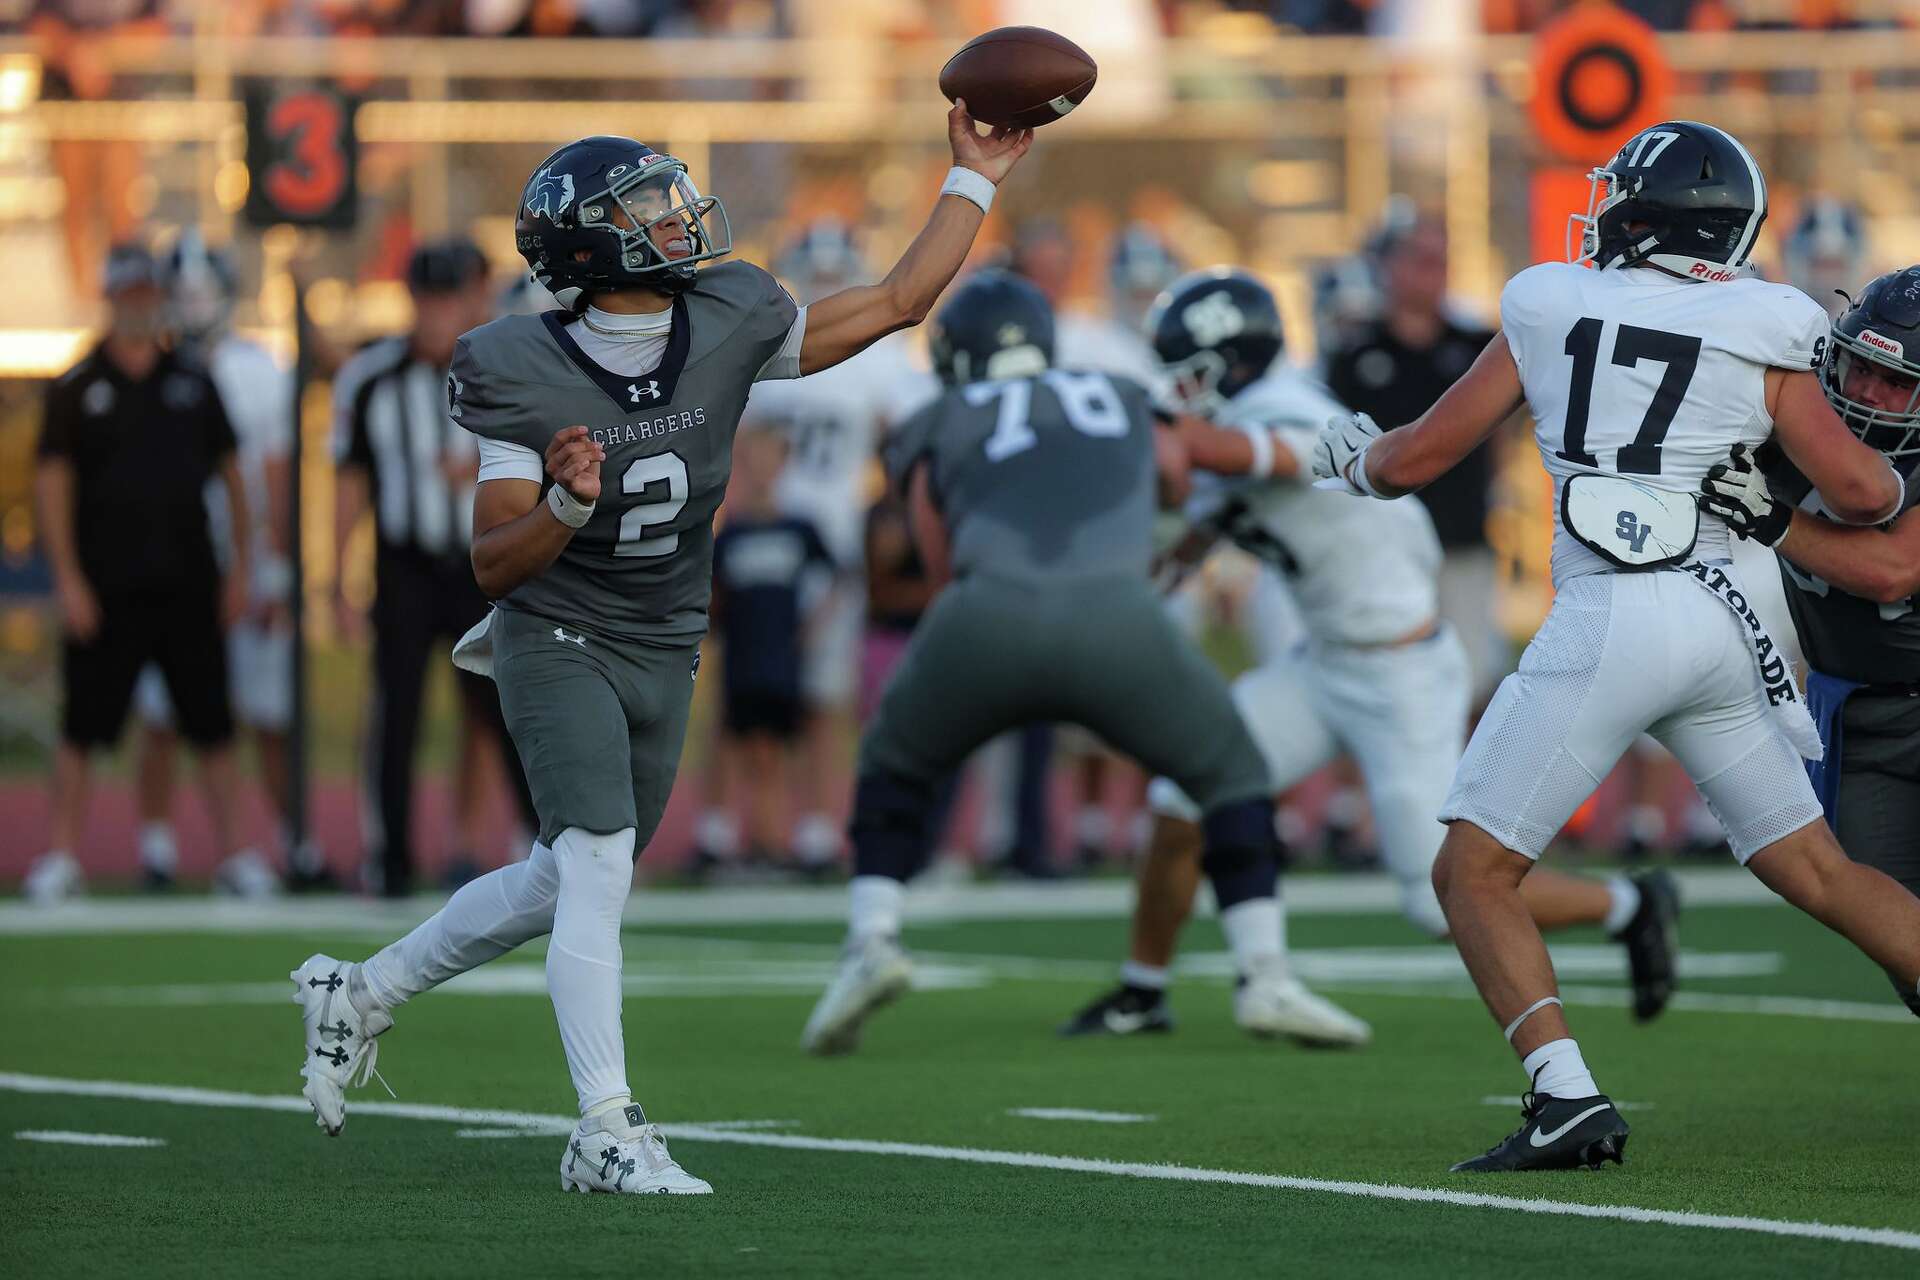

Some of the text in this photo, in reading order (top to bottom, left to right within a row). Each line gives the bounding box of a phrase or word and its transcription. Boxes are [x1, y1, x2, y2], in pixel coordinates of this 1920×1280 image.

[267, 92, 346, 213] 3
[1628, 131, 1681, 168] 17
[1810, 336, 1829, 368] S
[592, 407, 707, 448] CHARGERS
[965, 367, 1131, 463] 78
[1555, 316, 1703, 475] 17
[611, 449, 690, 559] 2
[1615, 510, 1652, 553] SV
